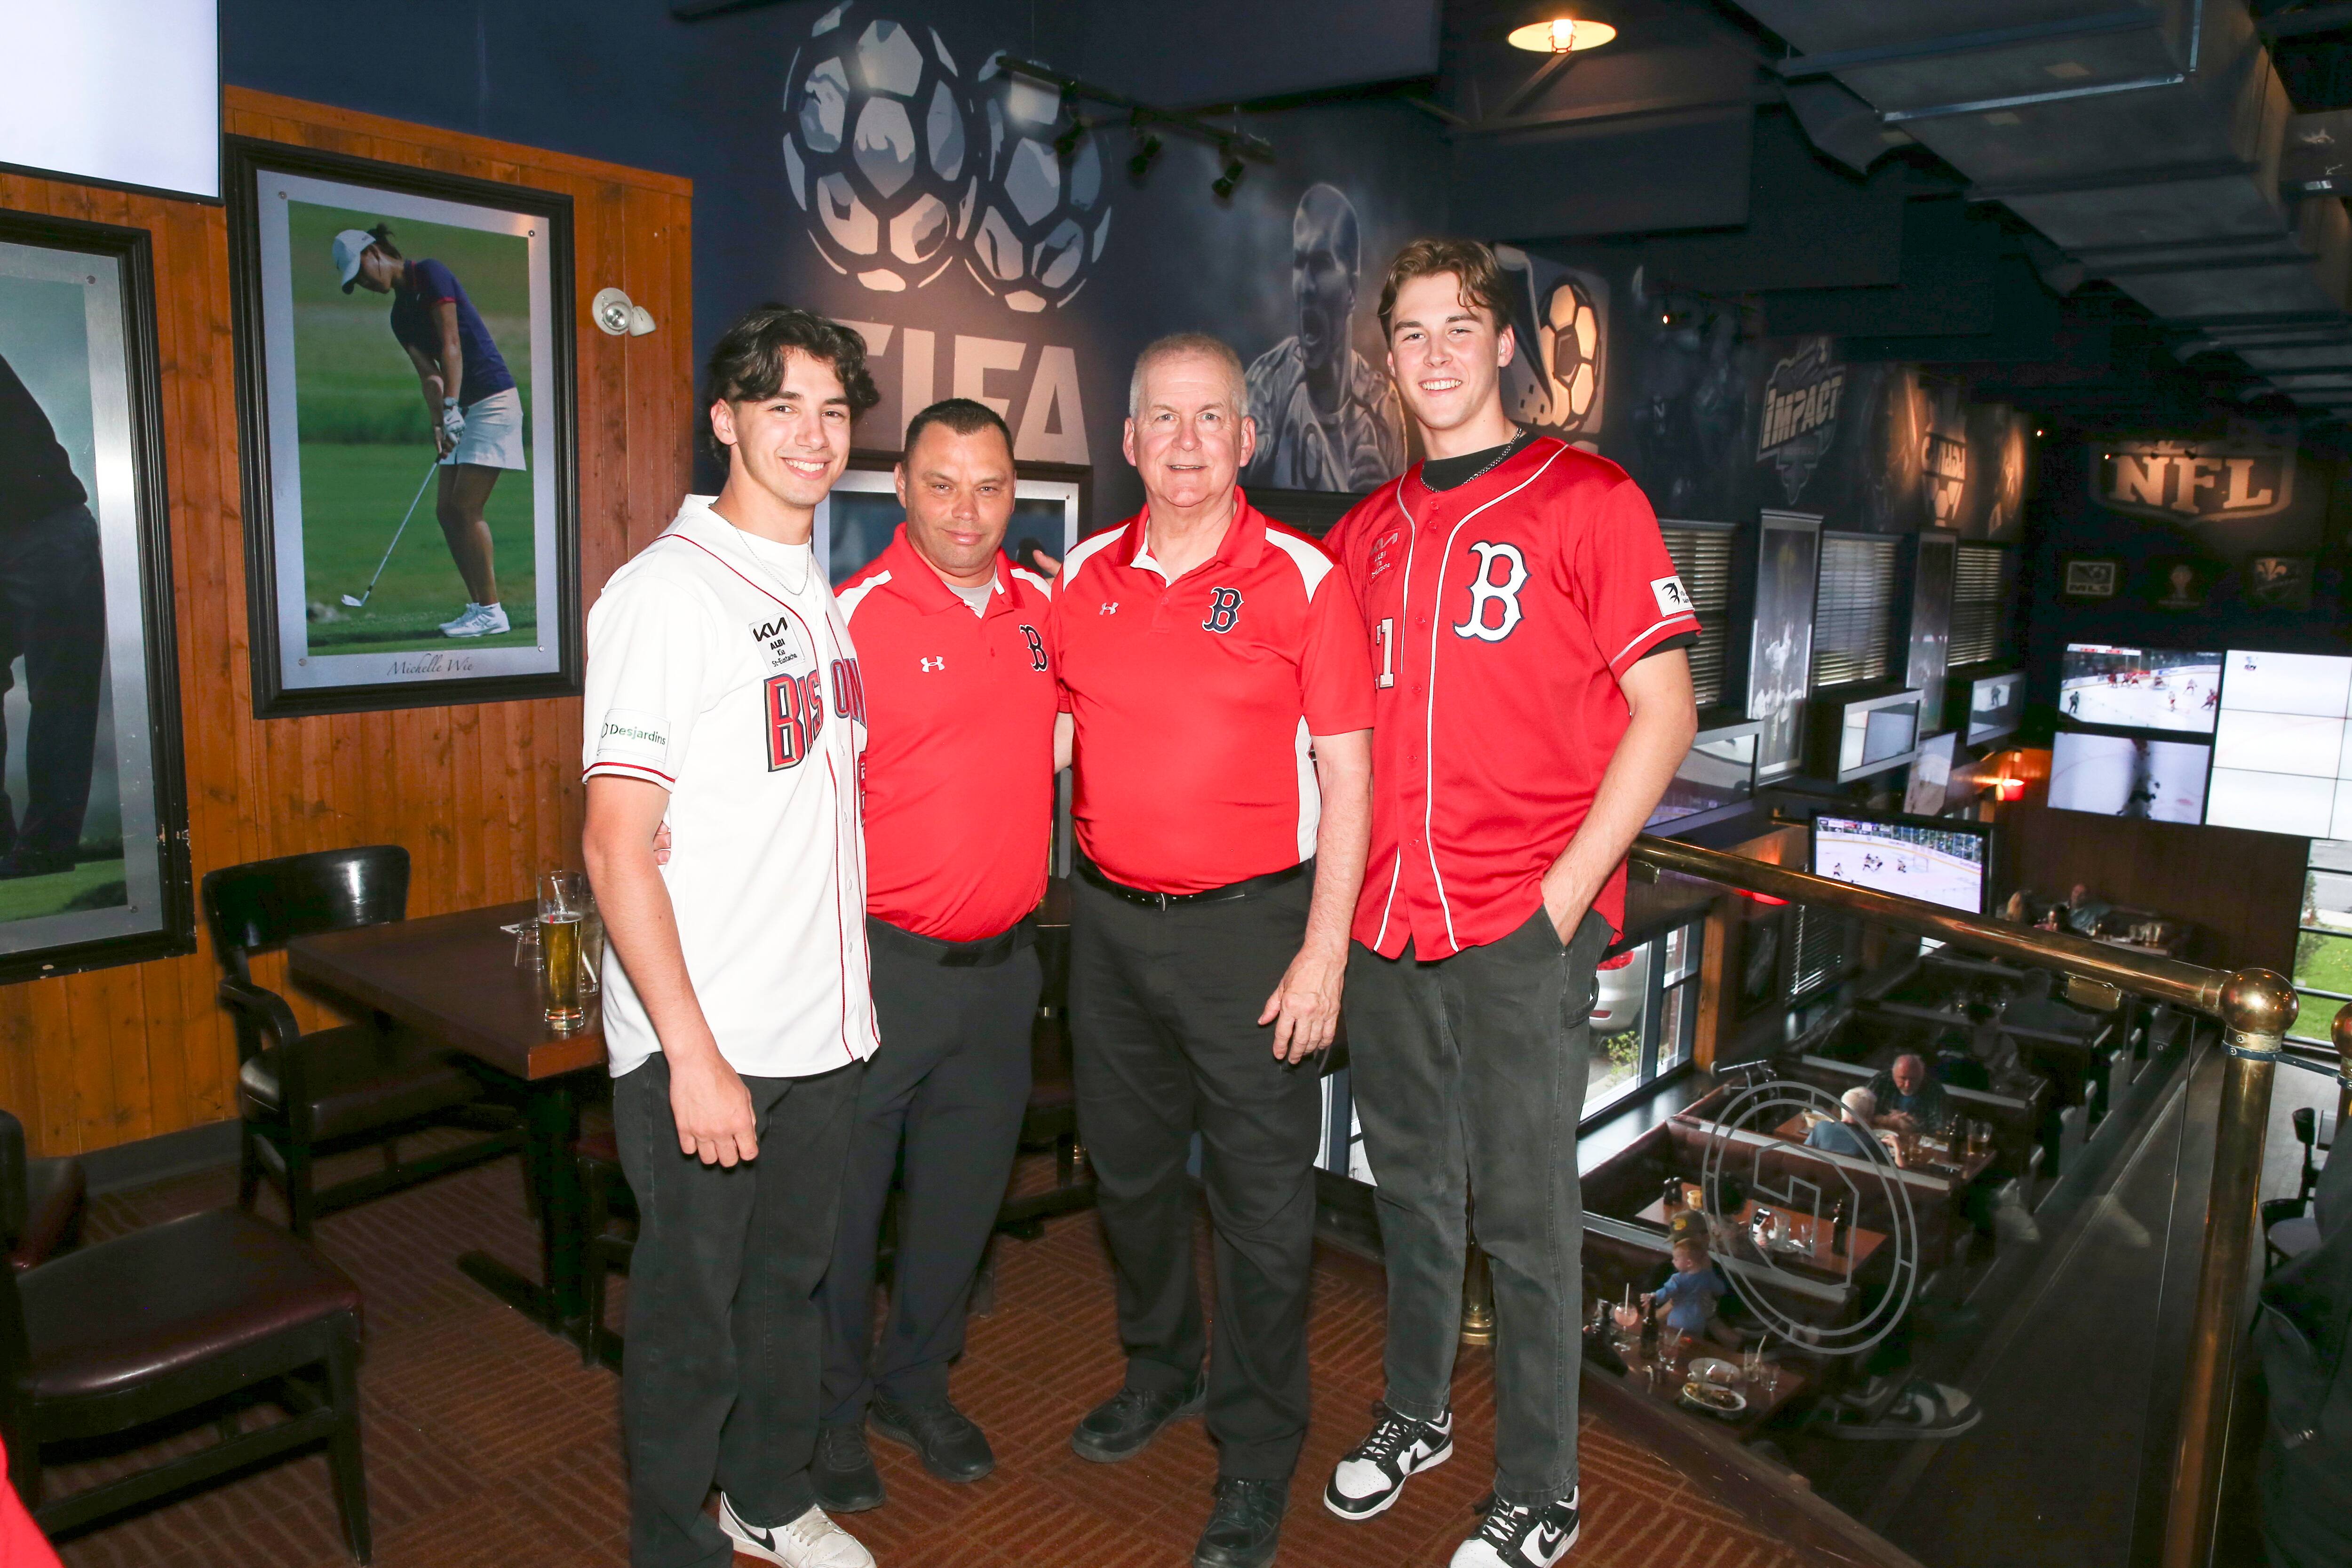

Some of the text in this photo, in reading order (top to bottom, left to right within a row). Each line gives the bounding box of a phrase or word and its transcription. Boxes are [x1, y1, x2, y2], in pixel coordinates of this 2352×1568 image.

[834, 318, 1090, 465] IFA
[1762, 375, 1842, 449] IMPACT
[1285, 418, 1323, 490] 10
[2110, 455, 2272, 513] NFL
[1202, 586, 1245, 634] B
[1453, 540, 1532, 643] B
[753, 617, 788, 642] KIA
[770, 638, 786, 650] ALBI
[1019, 623, 1048, 672] B
[387, 653, 473, 676] Michelle Wie
[772, 653, 798, 667] St-Eustache
[610, 724, 666, 746] Desjardins
